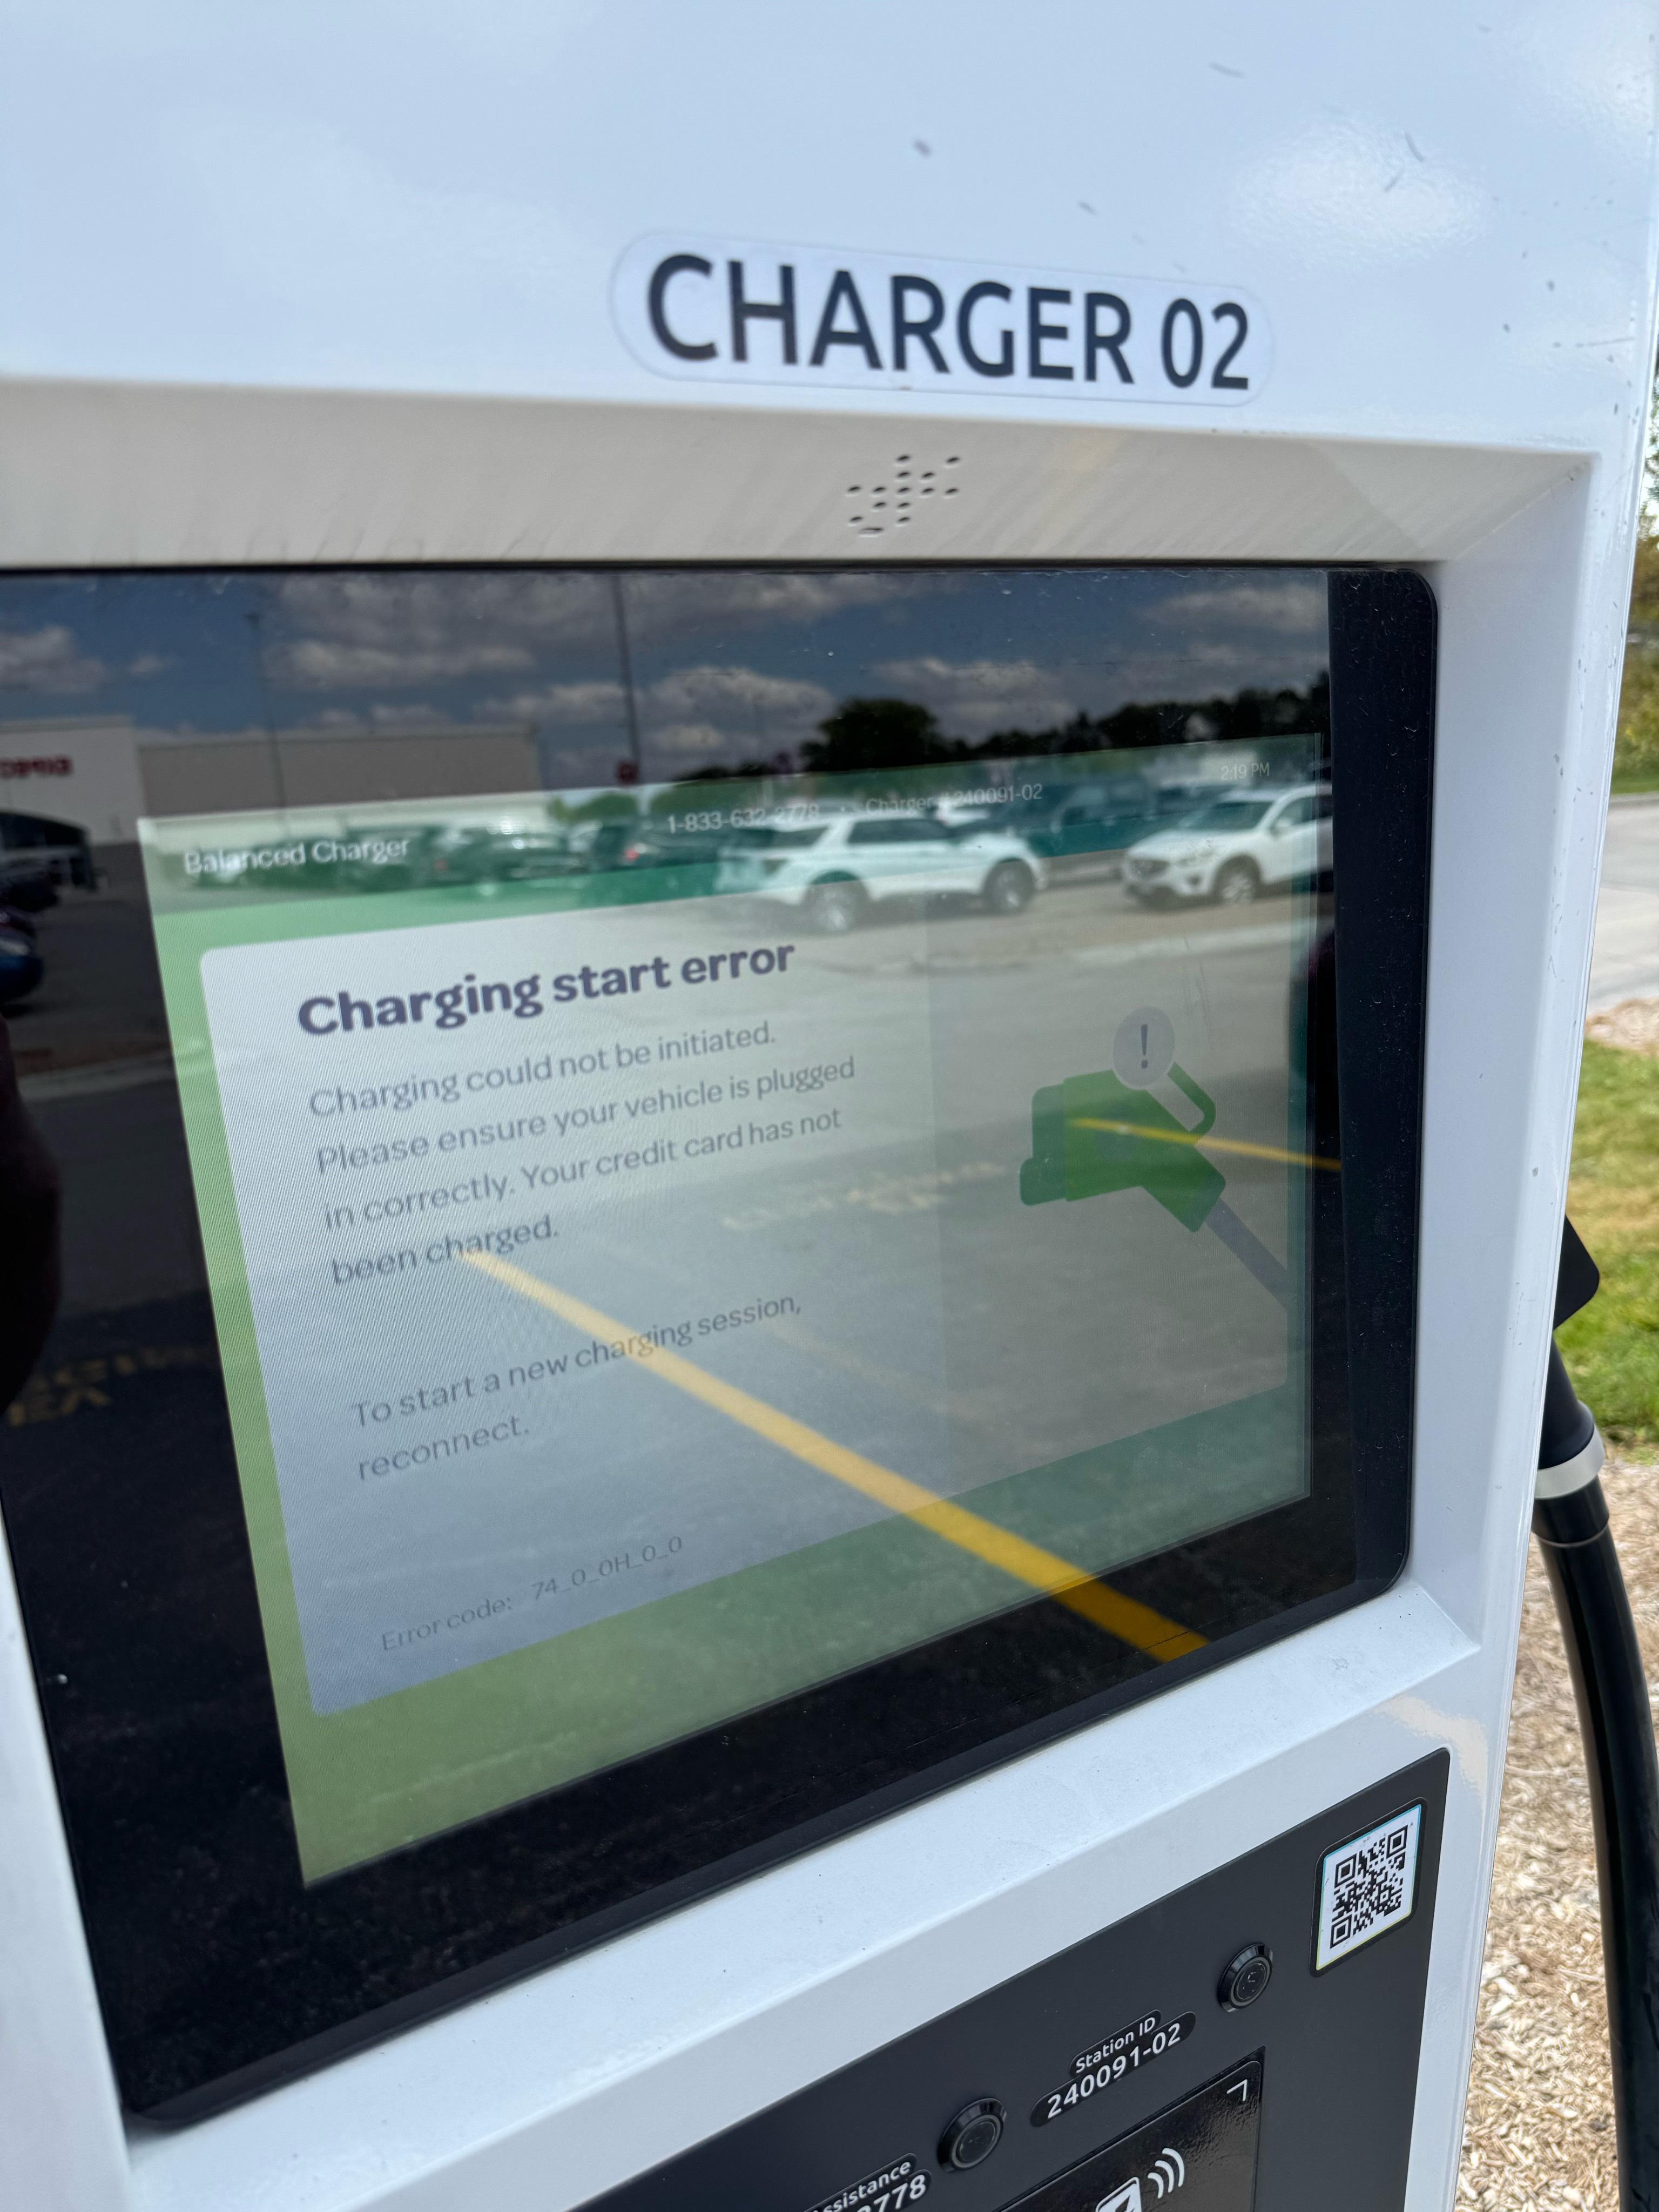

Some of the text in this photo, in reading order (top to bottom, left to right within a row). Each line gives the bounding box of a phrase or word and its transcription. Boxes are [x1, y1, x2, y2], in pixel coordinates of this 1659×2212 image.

[648, 253, 1249, 390] CHARGER 02
[1220, 761, 1270, 781] 2:19 PM
[667, 803, 819, 834] 1-833-632-2778
[866, 795, 933, 814] Charger
[184, 838, 409, 874] Balanced Charger
[298, 945, 795, 1035] Charging start error
[309, 1020, 776, 1117] Charging could not be initiated.
[318, 1055, 855, 1175] Please ensure your vehicle is plugged
[324, 1107, 842, 1230] in correctly. Your credit card has not
[332, 1213, 559, 1285] been charged.
[351, 1295, 801, 1427] To start a new charging session,
[358, 1415, 530, 1480] reconnect.
[382, 1620, 442, 1651] Error
[447, 1595, 512, 1629] code:
[1047, 2022, 1181, 2119] 240091-02
[1075, 2017, 1156, 2074] Station ID
[813, 2161, 911, 2212] ssistance
[857, 2174, 926, 2212] 778
